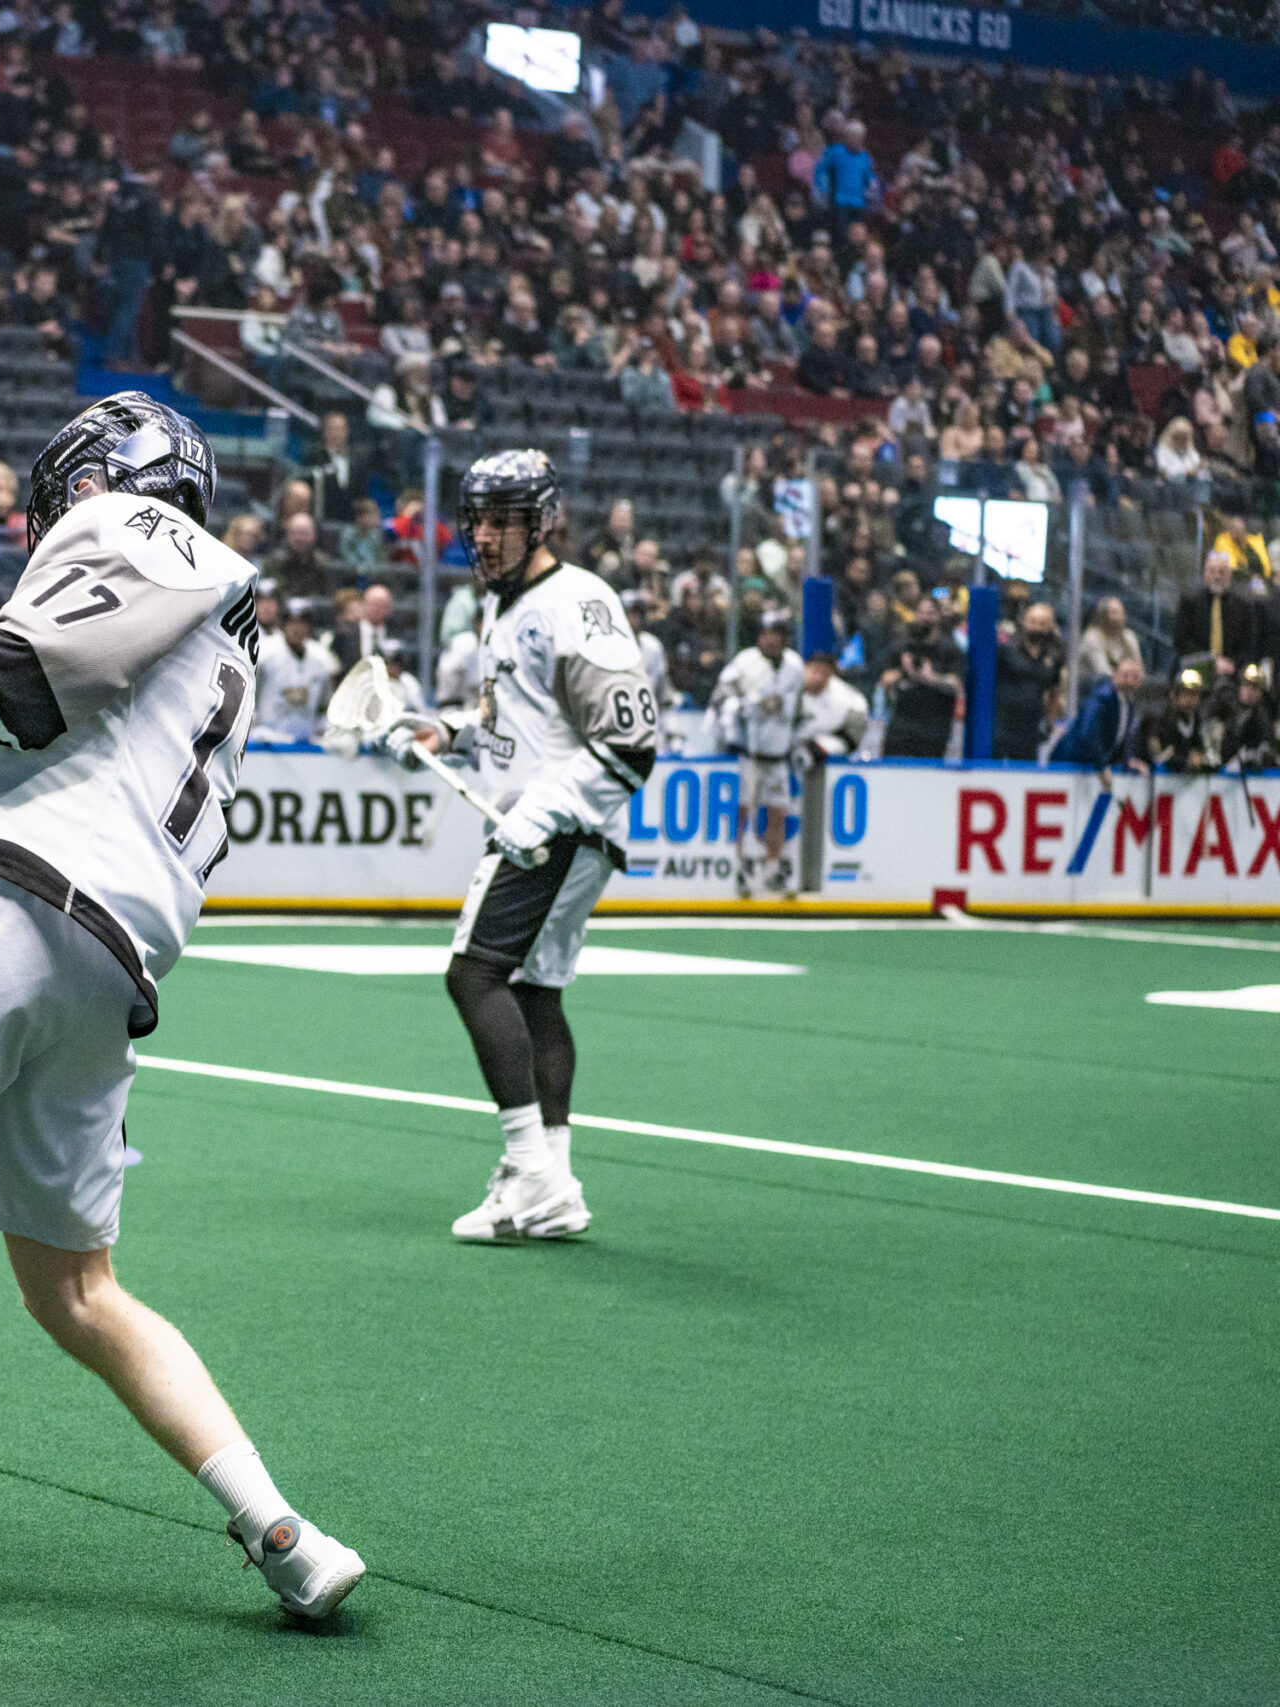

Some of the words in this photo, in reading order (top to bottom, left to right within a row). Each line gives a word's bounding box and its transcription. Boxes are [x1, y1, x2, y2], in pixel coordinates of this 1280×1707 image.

[977, 11, 1011, 48] GO
[184, 435, 204, 463] 17
[29, 565, 127, 630] 17
[613, 688, 657, 730] 68
[227, 789, 434, 846] ORADE
[662, 857, 733, 879] AUTO
